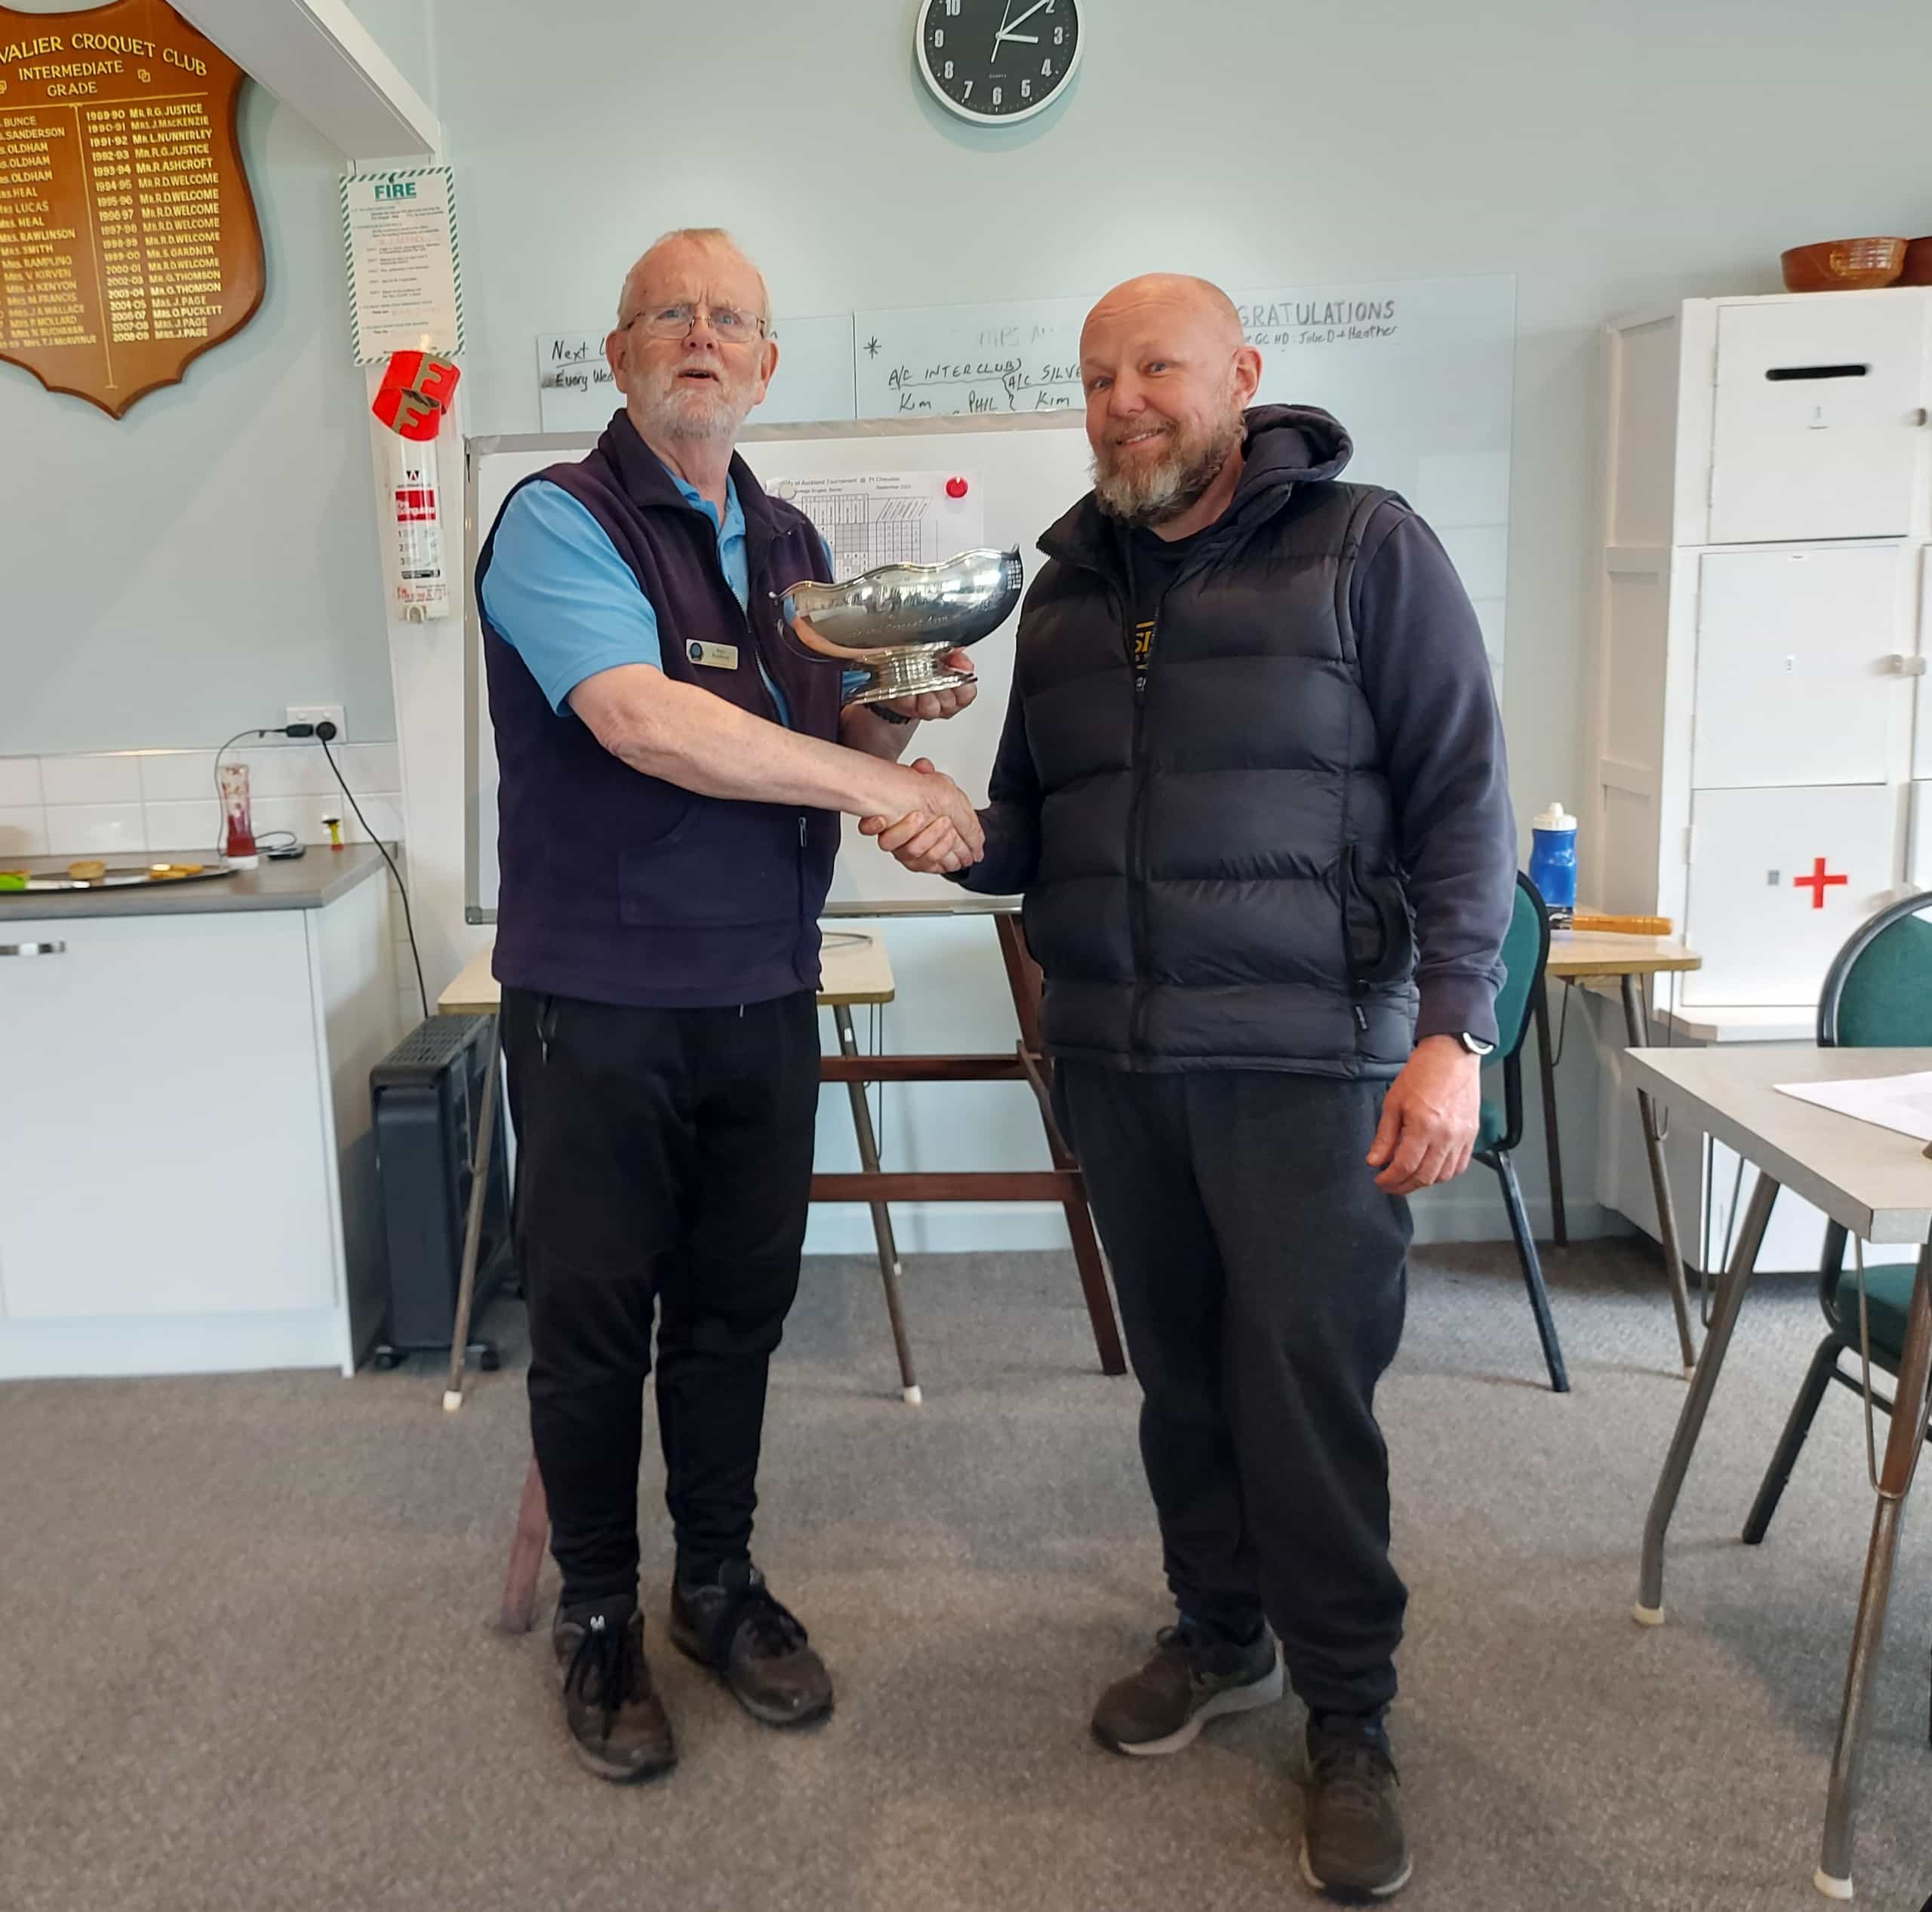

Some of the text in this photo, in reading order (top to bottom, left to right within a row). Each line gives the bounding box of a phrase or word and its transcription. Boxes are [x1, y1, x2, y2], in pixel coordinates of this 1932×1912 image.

[945, 0, 961, 16] 10
[934, 29, 943, 48] 9
[1054, 26, 1063, 45] 3
[72, 33, 155, 58] CROQUET
[162, 48, 208, 76] CLUB
[18, 60, 125, 81] INTERMEDIATE
[944, 60, 954, 79] 8
[1041, 59, 1052, 76] 4
[47, 81, 97, 97] GRADE
[964, 81, 974, 99] 7
[992, 87, 1002, 105] 6
[1021, 79, 1031, 97] 5
[3, 115, 36, 128] BUNCE
[5, 127, 66, 140] SANDERSON
[8, 141, 48, 155] OLDHAM
[9, 155, 51, 168] OLDHAM
[11, 170, 53, 183] OLDHAM
[13, 187, 38, 199] HEAL
[374, 182, 417, 200] FIRE
[15, 200, 49, 214] LUCAS
[18, 217, 45, 227] HEAL
[552, 340, 589, 362] Next
[888, 365, 912, 390] A/C
